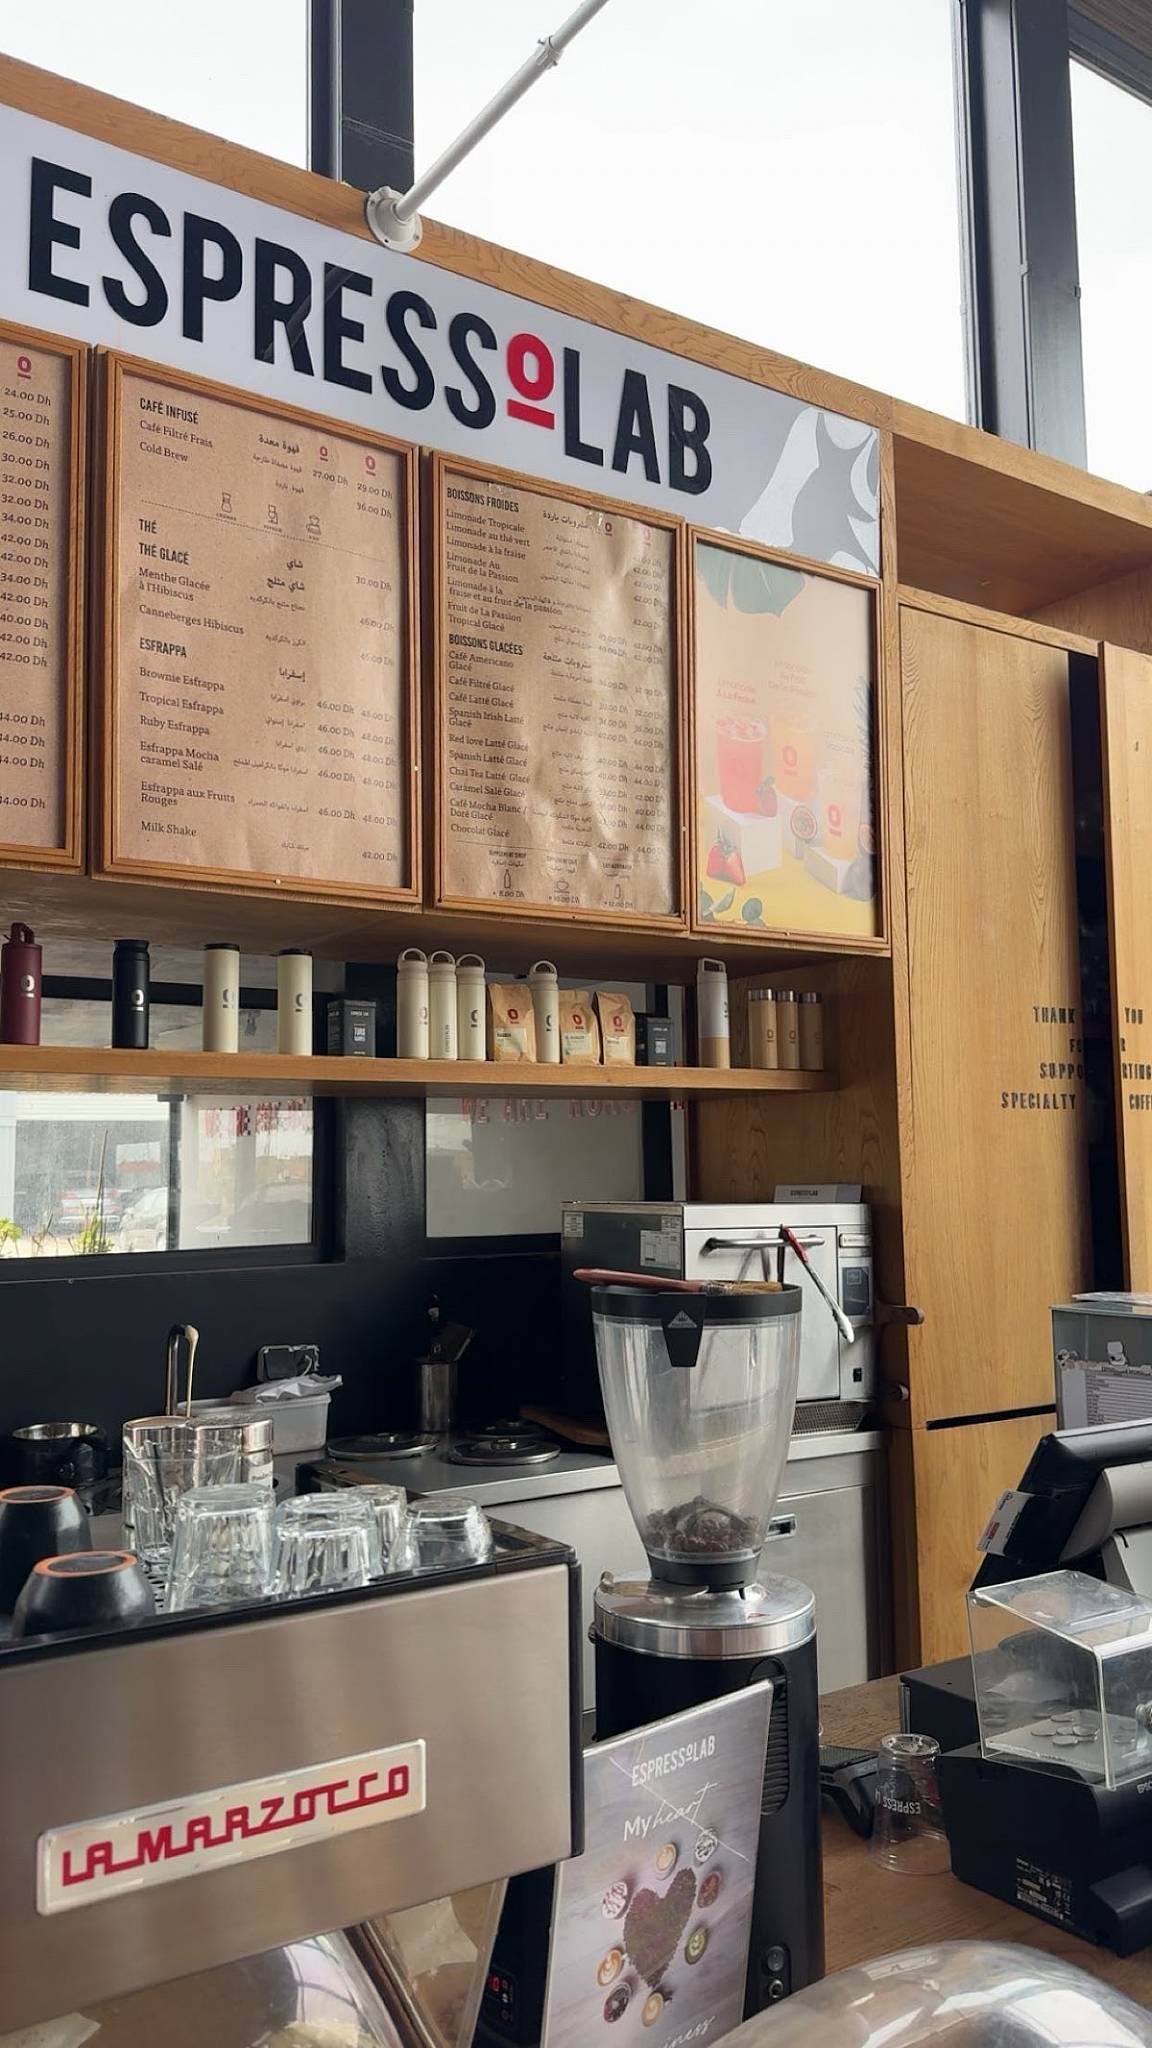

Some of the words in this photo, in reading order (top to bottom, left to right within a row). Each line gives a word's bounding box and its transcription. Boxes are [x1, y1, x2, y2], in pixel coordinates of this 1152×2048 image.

[28, 155, 713, 496] ESPRESSOLAB
[4, 387, 34, 401] 24.00
[36, 394, 51, 406] Dh
[3, 407, 33, 421] 25.00
[35, 413, 50, 426] Dh
[140, 397, 164, 415] CAFÉ
[166, 405, 199, 424] INFUSÉ
[2, 430, 33, 445] 26.00
[35, 437, 50, 449] Dh
[140, 420, 161, 433] Café
[163, 426, 188, 441] Filtré
[190, 433, 213, 448] Frais
[140, 441, 161, 456] Cold
[164, 447, 188, 462] Brew
[1, 453, 33, 467] 30.00
[35, 459, 50, 471] Dh
[1, 473, 33, 488] 32.00
[35, 480, 50, 491] Dh
[313, 470, 335, 482] 27.00
[357, 483, 380, 496] 29.00
[1, 493, 32, 507] 32.00
[34, 500, 49, 511] Dh
[357, 503, 379, 515] 36.00
[447, 487, 485, 506] BOISSONS
[486, 496, 519, 513] FROIDES
[1, 512, 32, 525] 34.00
[34, 518, 49, 529] Dh
[138, 519, 157, 534] THÉ
[446, 509, 487, 525] Limonade
[488, 517, 525, 533] Tropicale
[1, 533, 32, 546] 42.00
[34, 539, 49, 550] Dh
[446, 522, 487, 538] Limonade
[500, 534, 513, 544] thé
[514, 539, 530, 547] vert
[446, 536, 486, 552] Limonade
[1, 552, 32, 566] 42.00
[33, 557, 49, 568] Dh
[138, 542, 157, 558] THÉ
[160, 547, 189, 565] GLACÉ
[447, 551, 487, 567] Limonade
[489, 560, 500, 570] Au
[0, 572, 31, 585] 34.00
[33, 577, 49, 589] Dh
[139, 567, 177, 584] Menthe
[178, 576, 210, 591] Glacée
[447, 561, 466, 573] Fruit
[468, 565, 478, 574] de
[488, 569, 519, 583] Passion
[139, 581, 144, 590] à
[0, 592, 31, 605] 42.00
[33, 597, 49, 608] Dh
[448, 601, 466, 612] Fruit
[468, 605, 478, 614] de
[0, 613, 31, 626] 40.00
[33, 619, 49, 630] Dh
[139, 604, 201, 626] Canneberges
[203, 618, 244, 634] Hibiscus
[448, 613, 481, 628] Tropical
[482, 620, 505, 631] Glacé
[0, 632, 31, 645] 42.00
[33, 637, 49, 649] Dh
[140, 637, 187, 658] ESFRAPPA
[448, 633, 488, 649] BOISSONS
[489, 640, 523, 655] GLACÉES
[0, 652, 30, 664] 42.00
[32, 656, 48, 667] Dh
[448, 650, 468, 660] Café
[448, 661, 472, 671] Glacé
[140, 666, 181, 684] Brownie
[183, 675, 225, 692] Esfrappa
[448, 676, 468, 686] Café
[140, 691, 180, 708] Tropical
[182, 699, 224, 716] Esfrappa
[449, 692, 467, 701] Café
[140, 715, 165, 730] Ruby
[167, 719, 210, 736] Esfrappa
[140, 741, 184, 757] Esfrappa
[186, 748, 220, 762] Mocha
[449, 750, 482, 761] Spanish
[506, 756, 527, 767] Glacé
[140, 755, 180, 769] caramel
[182, 759, 203, 772] Salé
[141, 781, 185, 797] Esfrappa
[186, 789, 205, 800] aux
[207, 791, 235, 804] Fruits
[449, 781, 483, 794] Caramel
[141, 793, 178, 808] Rouges
[141, 821, 165, 833] Milk
[167, 824, 197, 838] Shake
[450, 824, 485, 835] Chocolat
[1033, 1006, 1076, 1024] THANK
[1125, 1008, 1143, 1024] YOU
[1001, 1091, 1076, 1110] SPECIALTY
[632, 1735, 716, 1787] ESPRESSOLAB
[624, 1815, 652, 1841] My
[652, 1781, 718, 1830] heart
[62, 1840, 112, 1887] LA
